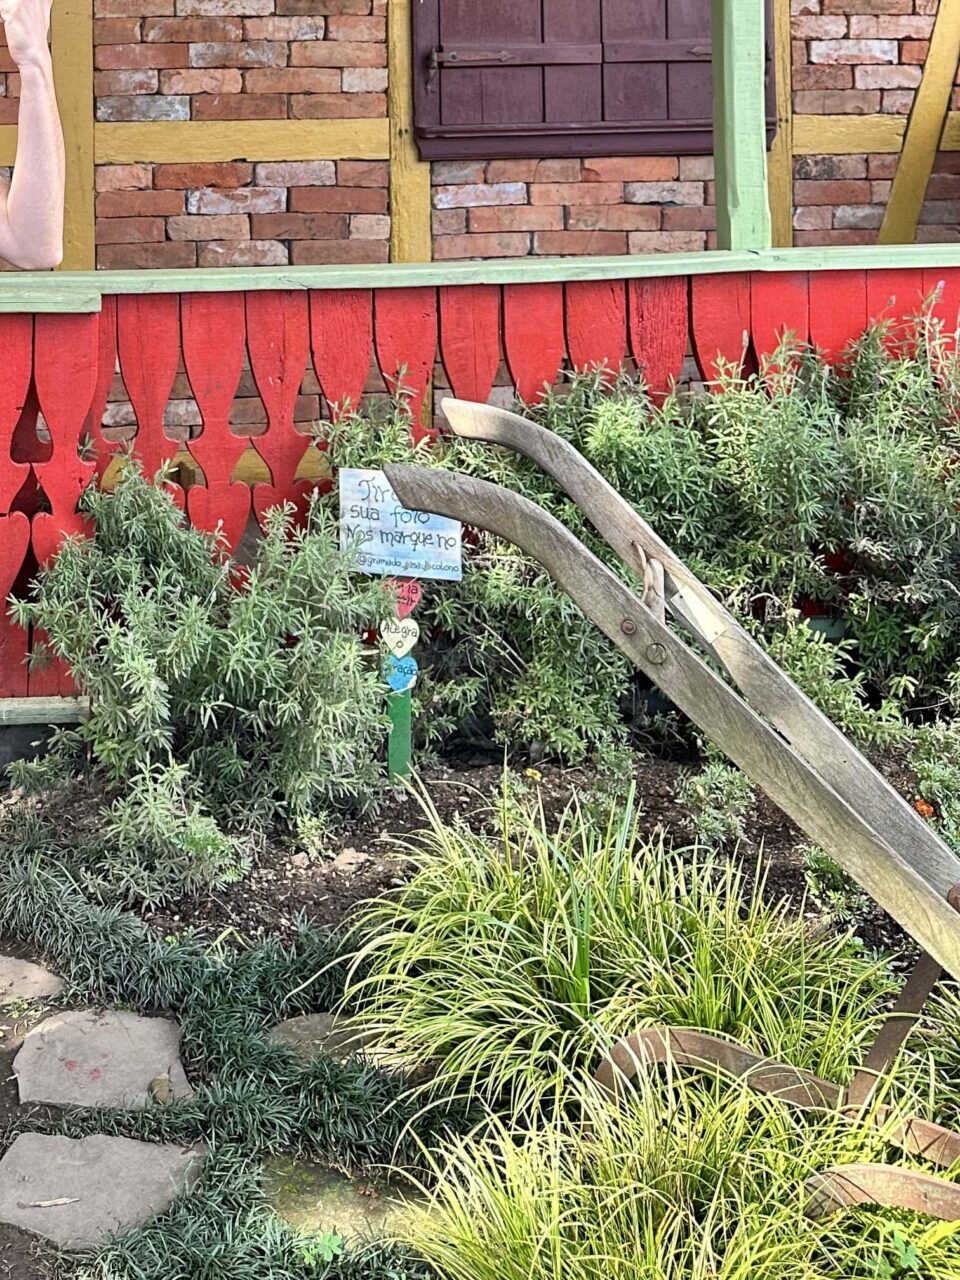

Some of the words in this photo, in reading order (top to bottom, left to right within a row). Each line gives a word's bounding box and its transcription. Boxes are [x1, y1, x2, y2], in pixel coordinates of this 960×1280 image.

[350, 503, 380, 521] sua
[379, 527, 434, 552] marque
[436, 533, 457, 551] no
